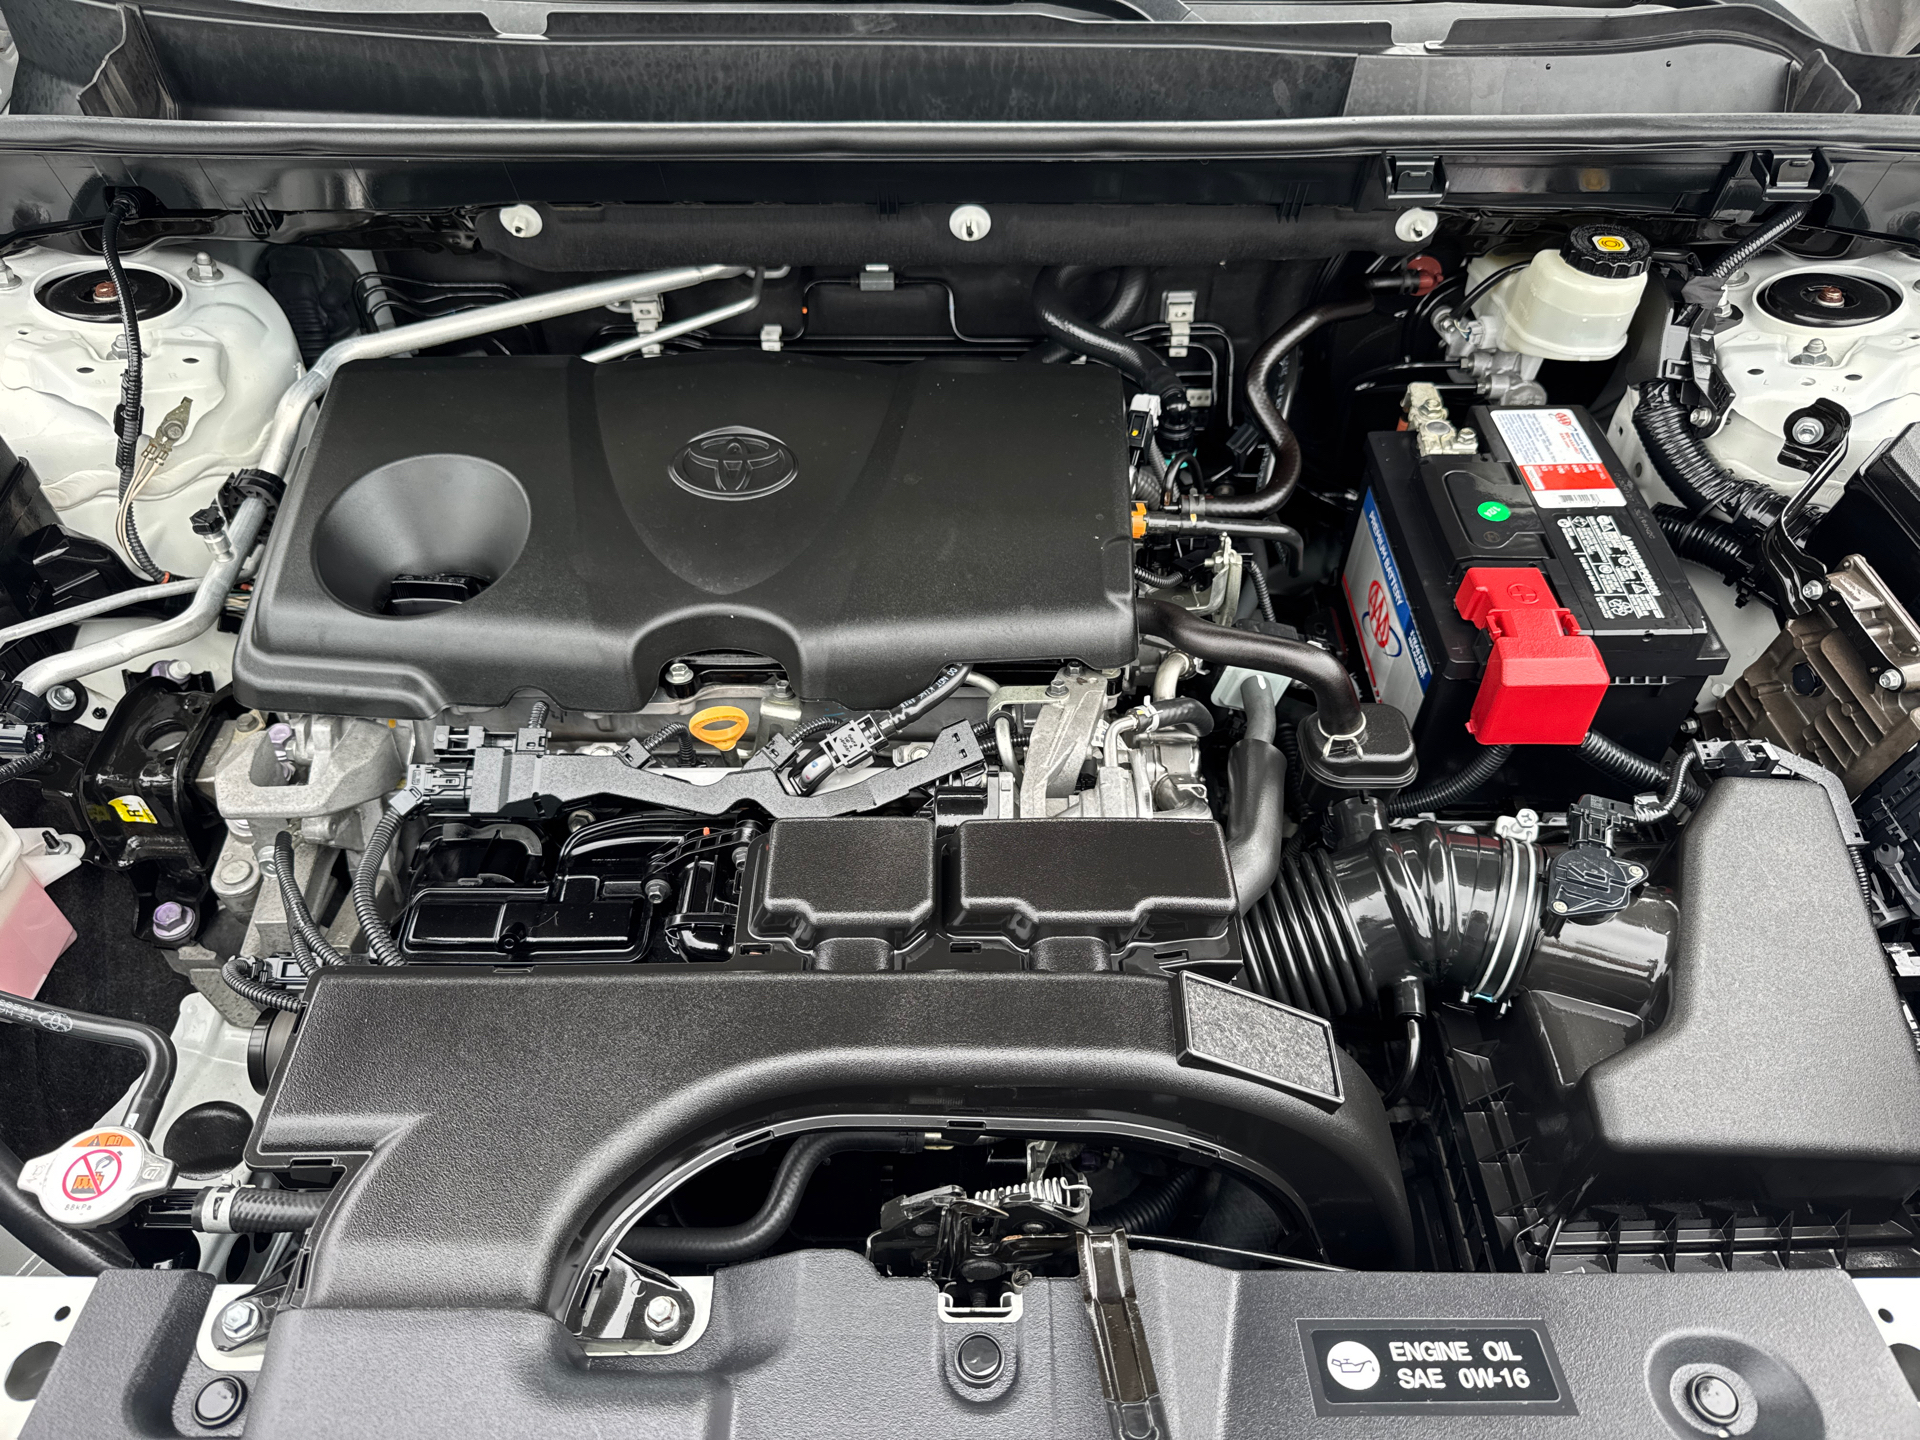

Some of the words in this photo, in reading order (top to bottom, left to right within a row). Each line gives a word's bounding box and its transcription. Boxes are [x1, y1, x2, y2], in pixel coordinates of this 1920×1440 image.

[1369, 510, 1388, 560] PREMIUM
[1384, 557, 1404, 606] BATTERY
[1368, 580, 1390, 648] AAA
[64, 1202, 92, 1211] 88kPa
[1388, 1341, 1472, 1361] ENGINE
[1483, 1341, 1522, 1361] OIL
[1397, 1368, 1446, 1389] SAE
[1458, 1368, 1530, 1388] 0W-16
